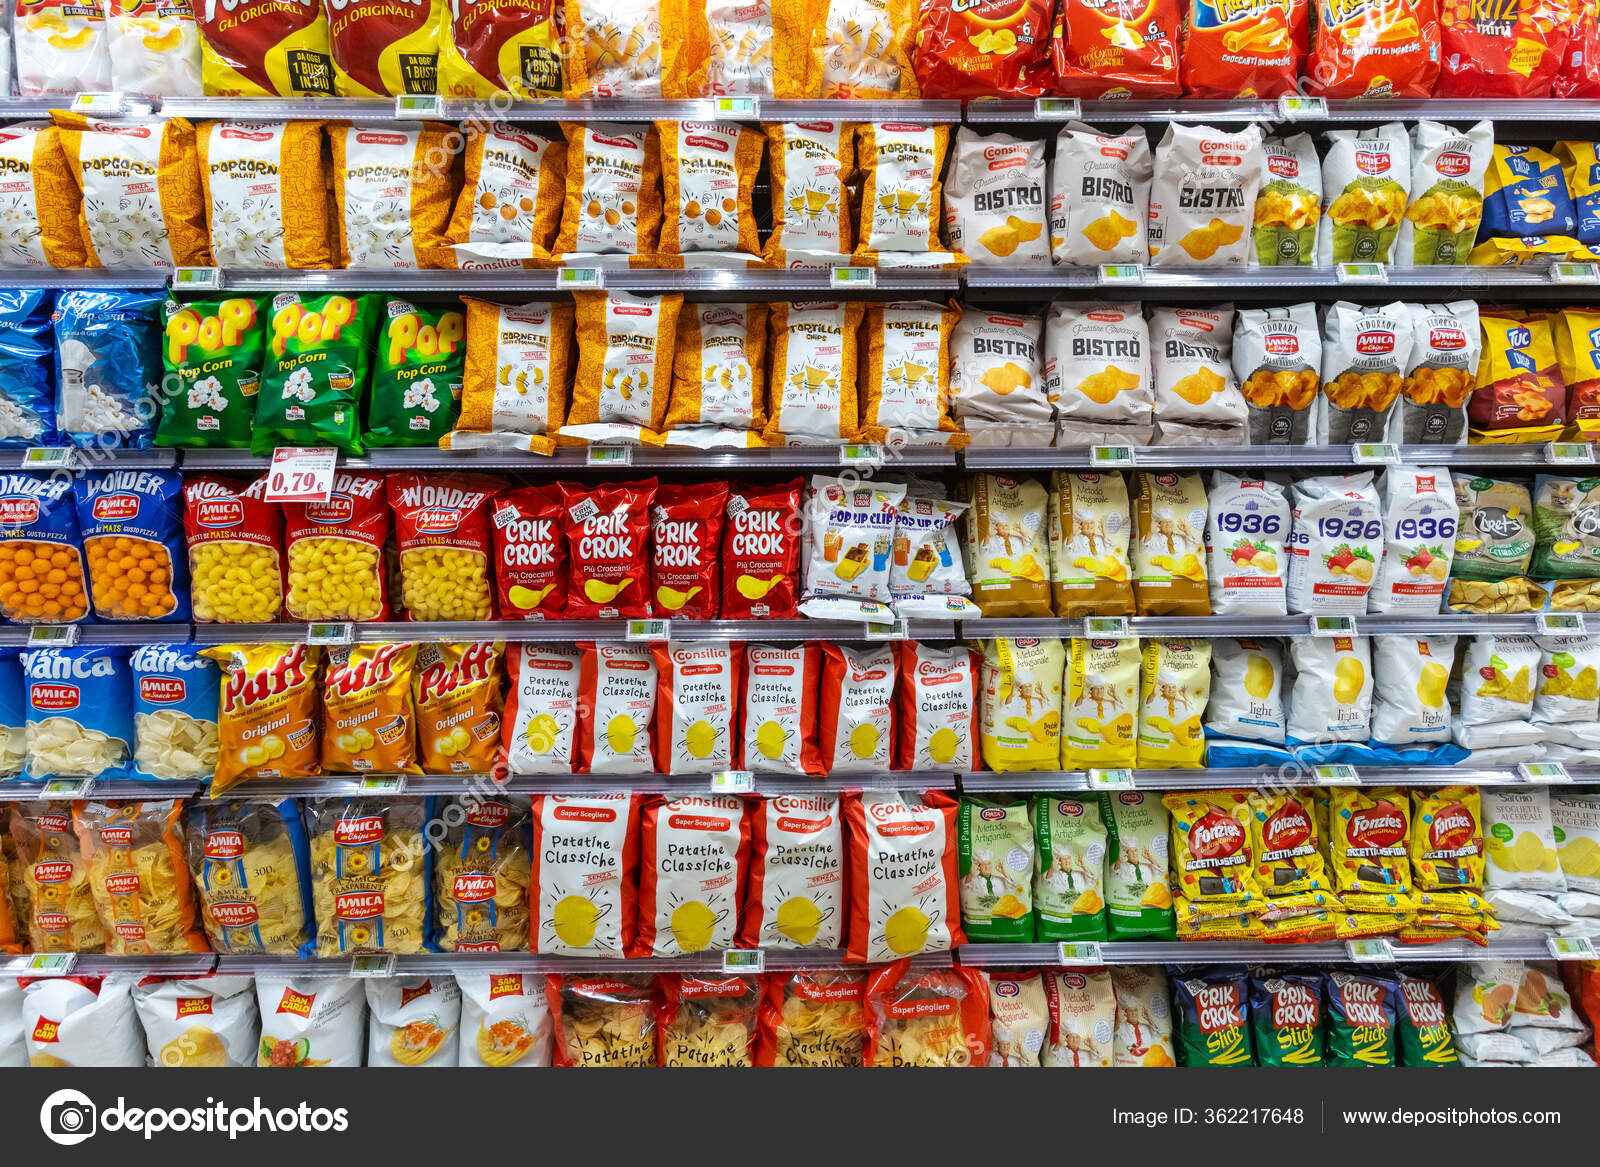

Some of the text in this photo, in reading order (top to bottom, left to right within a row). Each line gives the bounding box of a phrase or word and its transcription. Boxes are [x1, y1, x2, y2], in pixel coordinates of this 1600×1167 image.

[218, 1, 303, 32] GLI ORIGINALI
[333, 5, 413, 38] GLI ORIGINALI
[463, 14, 476, 31] GLI
[1022, 21, 1031, 36] 6
[1148, 21, 1158, 34] 6
[1477, 21, 1512, 37] mini
[293, 62, 298, 73] 1
[984, 145, 1030, 160] Consilia
[1200, 138, 1247, 154] Consilia
[210, 158, 279, 177] POPCORN
[484, 149, 537, 177] PALLINE
[585, 155, 642, 173] PALLINE
[681, 158, 735, 172] PALLINE
[1437, 155, 1470, 166] AMICA
[974, 183, 1042, 212] BISTRÒ
[1081, 176, 1134, 205] BISTRÒ
[1175, 308, 1220, 322] Consilia
[1073, 336, 1141, 357] BISTRÒ
[1358, 335, 1394, 345] AMICA
[178, 358, 233, 380] Pop Corn
[278, 352, 327, 371] Pop Corn
[397, 364, 447, 381] Pop Corn
[87, 471, 166, 497] WONDER
[97, 498, 137, 510] AMICA
[402, 485, 485, 509] WONDER
[200, 503, 240, 514] AMICA
[583, 512, 630, 536] CRIK
[735, 510, 781, 532] CRIK
[830, 511, 852, 523] POP
[853, 513, 868, 524] UP
[1217, 512, 1280, 534] 1936
[102, 524, 158, 537] MAIS PIZZA
[210, 529, 230, 540] MAIS
[238, 532, 271, 542] FORMAGGIO
[319, 527, 375, 541] MAIS FORMAGGIO
[506, 519, 553, 543] CRIK
[655, 521, 699, 544] CRIK
[1318, 517, 1382, 539] 1936
[1395, 518, 1456, 540] 1936
[47, 532, 67, 540] PIZZA
[427, 536, 446, 545] MAIS
[579, 537, 633, 560] CROK
[732, 533, 784, 556] CROK
[504, 542, 555, 567] CROK
[597, 564, 631, 573] Croccanti
[736, 561, 783, 569] Più Croccanti
[666, 572, 699, 580] Croccanti
[673, 648, 727, 664] Consilia
[750, 648, 800, 663] Consilia
[1016, 648, 1045, 660] Metodo
[418, 642, 494, 705] Puff
[918, 660, 967, 675] Consilia
[141, 679, 183, 692] AMICA
[224, 643, 309, 714] Puff
[608, 676, 648, 687] Patatine
[32, 686, 78, 699] AMICA
[602, 686, 651, 699] Classiche
[682, 682, 722, 693] Patatine
[755, 683, 793, 693] Patatine
[925, 690, 963, 700] Patatine
[678, 692, 726, 705] Classiche
[751, 693, 797, 705] Classiche
[921, 701, 968, 712] Classiche
[1250, 702, 1272, 718] light
[336, 707, 378, 729] Original
[435, 706, 475, 730] Original
[1422, 711, 1444, 727] light
[242, 712, 291, 740] Original
[560, 810, 610, 819] Saper Scegliere
[335, 820, 382, 834] AMICA
[675, 818, 725, 828] Saper Scegliere
[882, 824, 930, 833] Saper Scegliere
[1353, 814, 1402, 837] Fonzies
[1434, 814, 1471, 834] Fonzies
[207, 836, 241, 848] AMICA
[348, 832, 370, 841] Chips
[552, 836, 611, 850] Patatine
[1194, 822, 1241, 849] Fonzies
[668, 844, 725, 857] Patatine
[879, 848, 935, 864] Patatine
[545, 851, 616, 868] Classiche
[662, 858, 732, 873] Classiche
[35, 864, 73, 875] AMICA
[873, 861, 937, 880] Classiche
[106, 876, 139, 887] AMICA
[455, 879, 495, 891] AMICA
[337, 895, 383, 909] AMICA
[493, 983, 521, 994] CARLO
[497, 977, 516, 986] SAN
[682, 984, 740, 993] Saper Scegliere
[289, 994, 309, 1005] SAN
[1199, 985, 1235, 1008] CRIK
[1277, 984, 1313, 1007] CRIK
[179, 1004, 210, 1014] CARLO
[185, 999, 205, 1008] SAN
[281, 1001, 310, 1013] CARLO
[892, 1003, 951, 1014] Saper Scegliere
[1200, 1004, 1239, 1029] CROK
[1275, 1002, 1316, 1025] CROK
[1347, 1003, 1385, 1024] CROK
[1206, 1025, 1241, 1053] Stick
[1277, 1024, 1314, 1049] Stick
